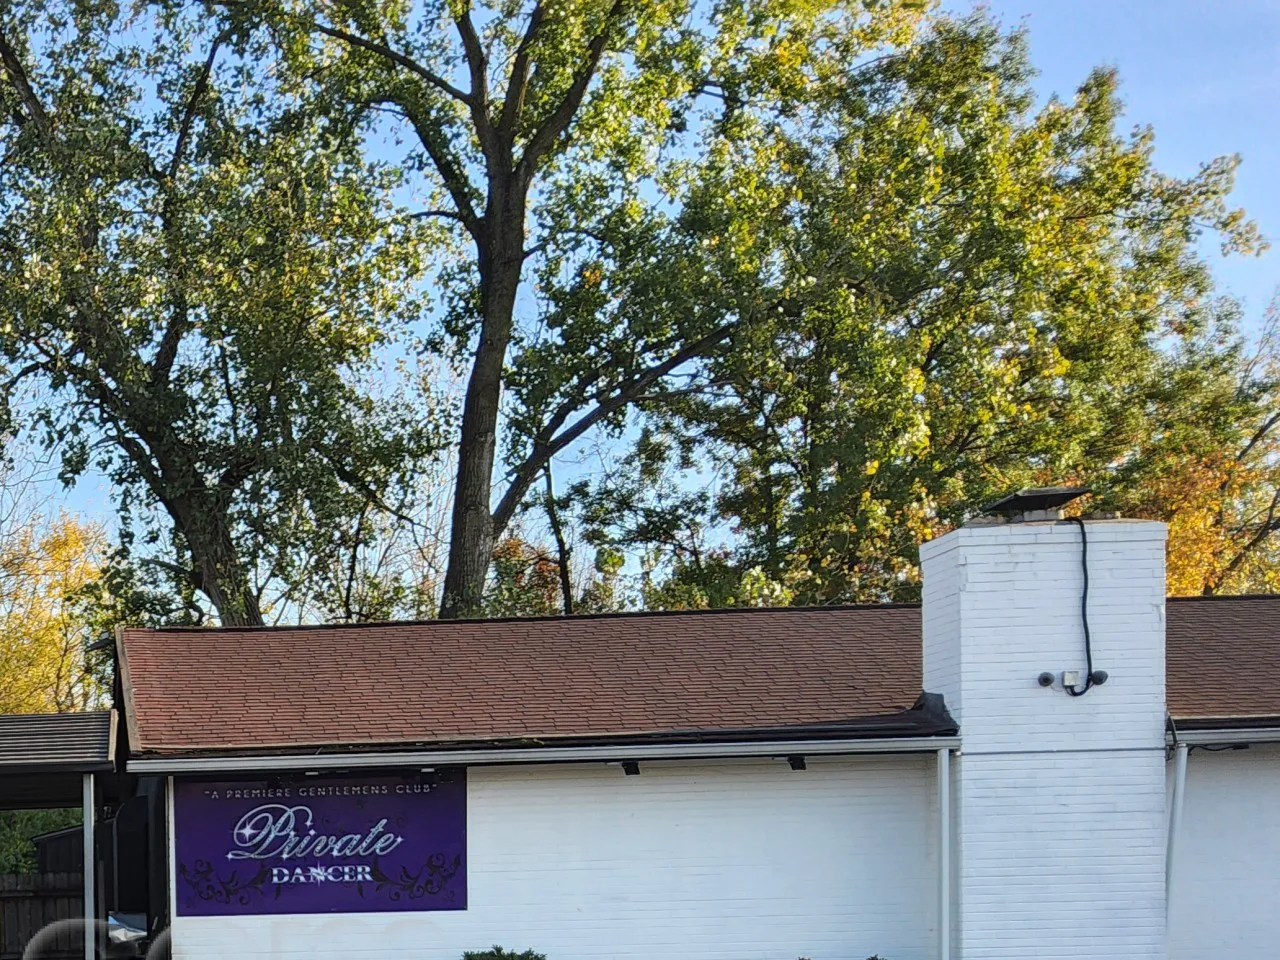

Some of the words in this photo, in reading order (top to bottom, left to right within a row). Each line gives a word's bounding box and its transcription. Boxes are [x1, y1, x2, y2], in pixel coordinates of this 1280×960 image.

[204, 787, 219, 799] "A
[226, 786, 291, 799] PREMIERE
[298, 785, 388, 796] GENTLEMENS
[395, 783, 437, 794] CLUB"
[226, 804, 404, 860] Private
[271, 866, 374, 884] DANCER
